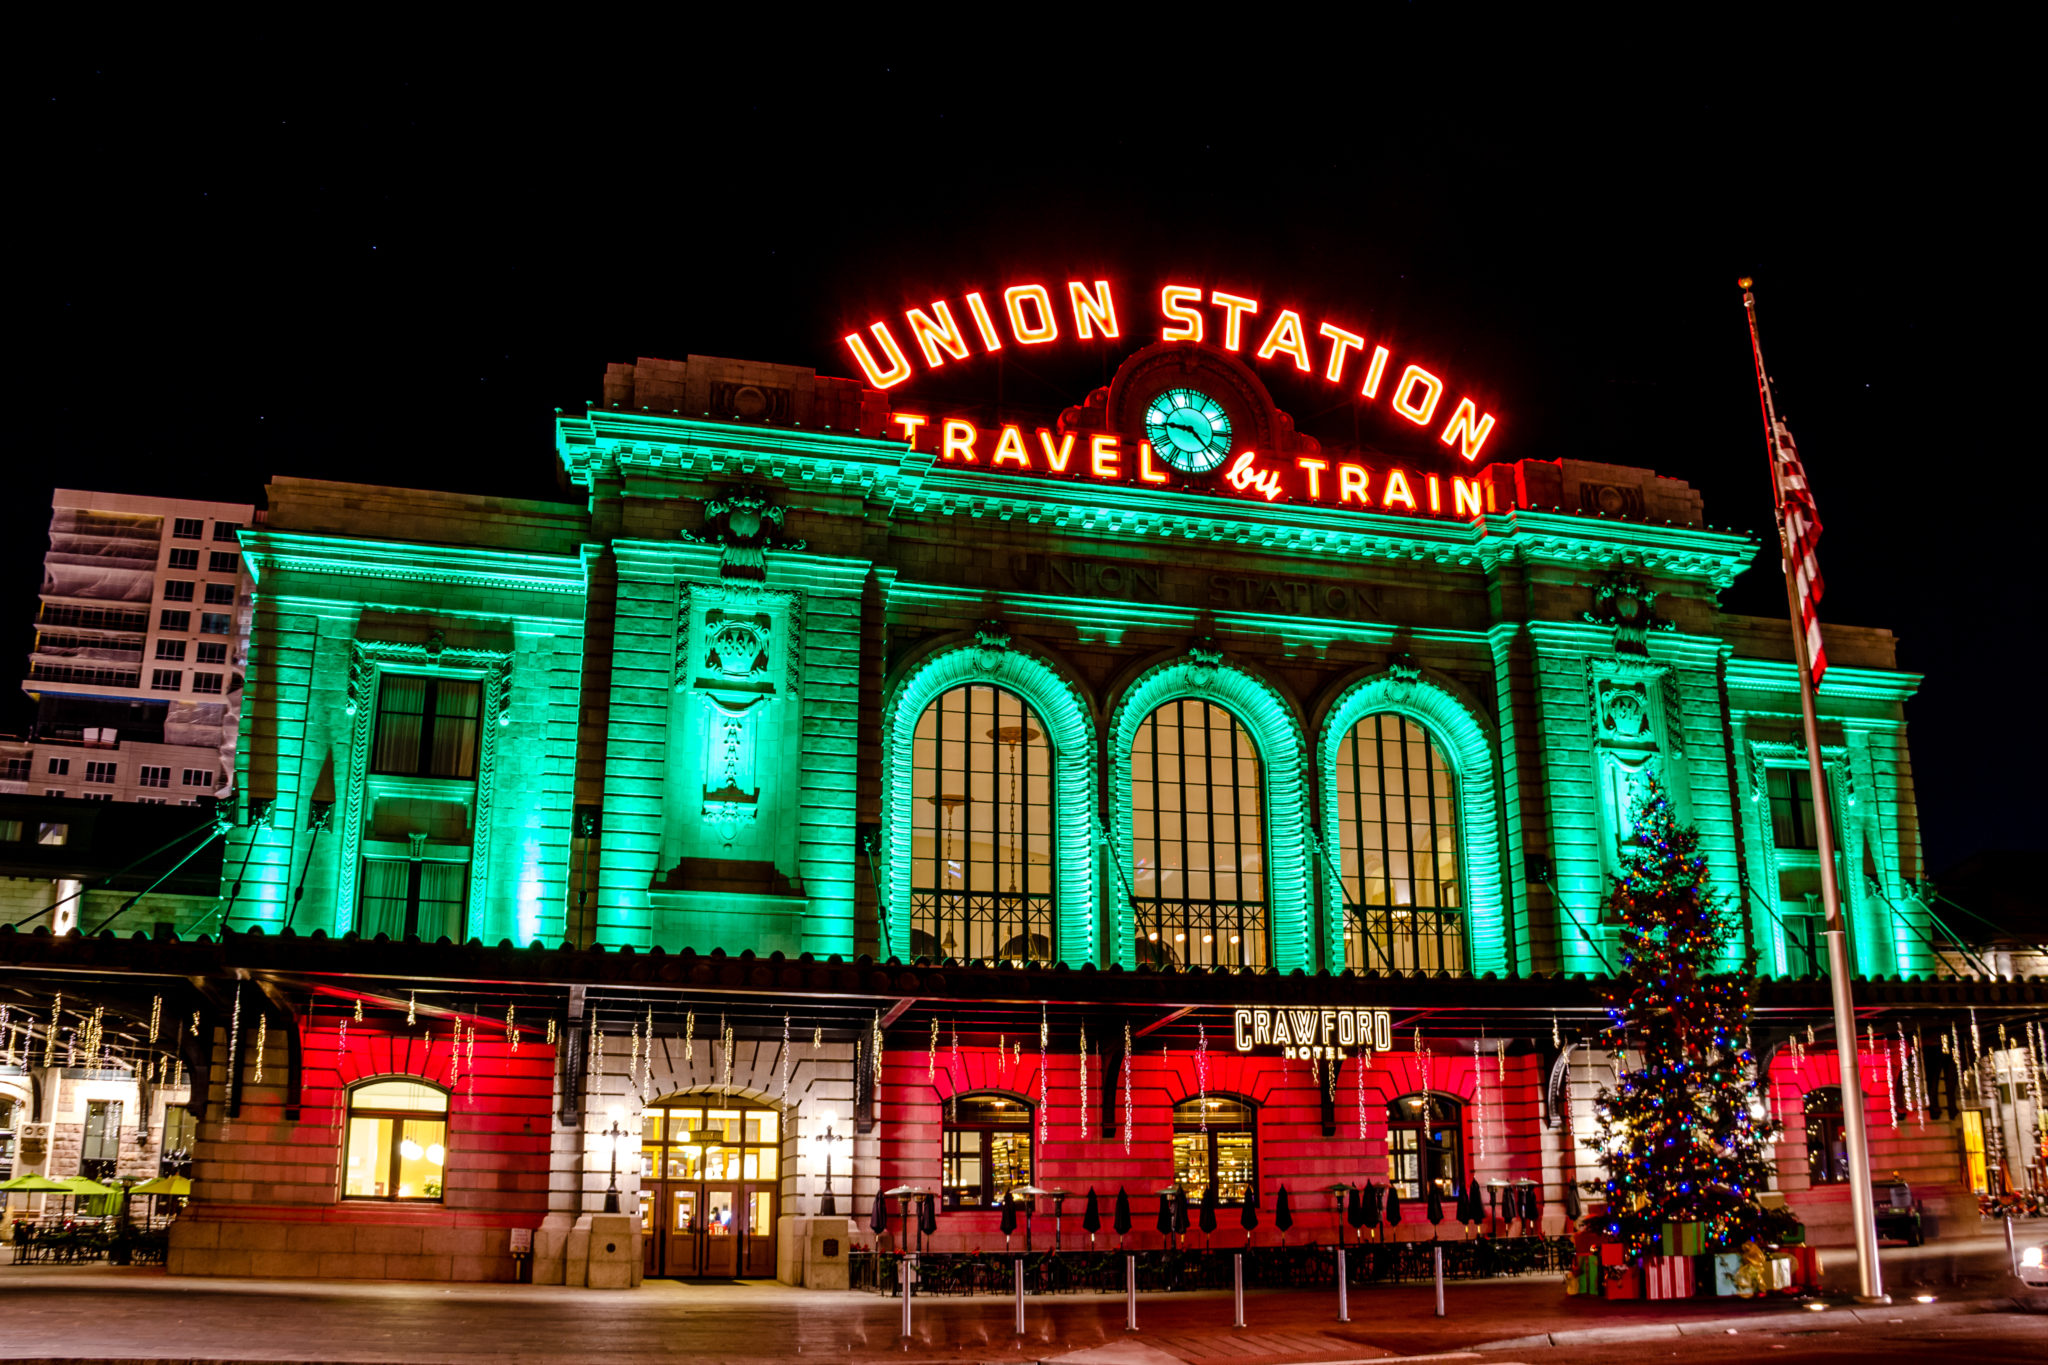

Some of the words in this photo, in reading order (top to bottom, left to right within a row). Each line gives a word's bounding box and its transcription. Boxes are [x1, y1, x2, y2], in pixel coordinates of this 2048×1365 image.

[844, 280, 1119, 390] UNION
[1161, 284, 1496, 462] STATION
[892, 411, 1169, 484] TRAVEL
[1224, 451, 1283, 501] by
[1296, 456, 1483, 517] TRAIN
[1010, 553, 1162, 598] UNION
[1208, 573, 1383, 617] STATION
[1235, 1009, 1392, 1051] CRAWFORD
[1284, 1046, 1348, 1060] HOTEL
